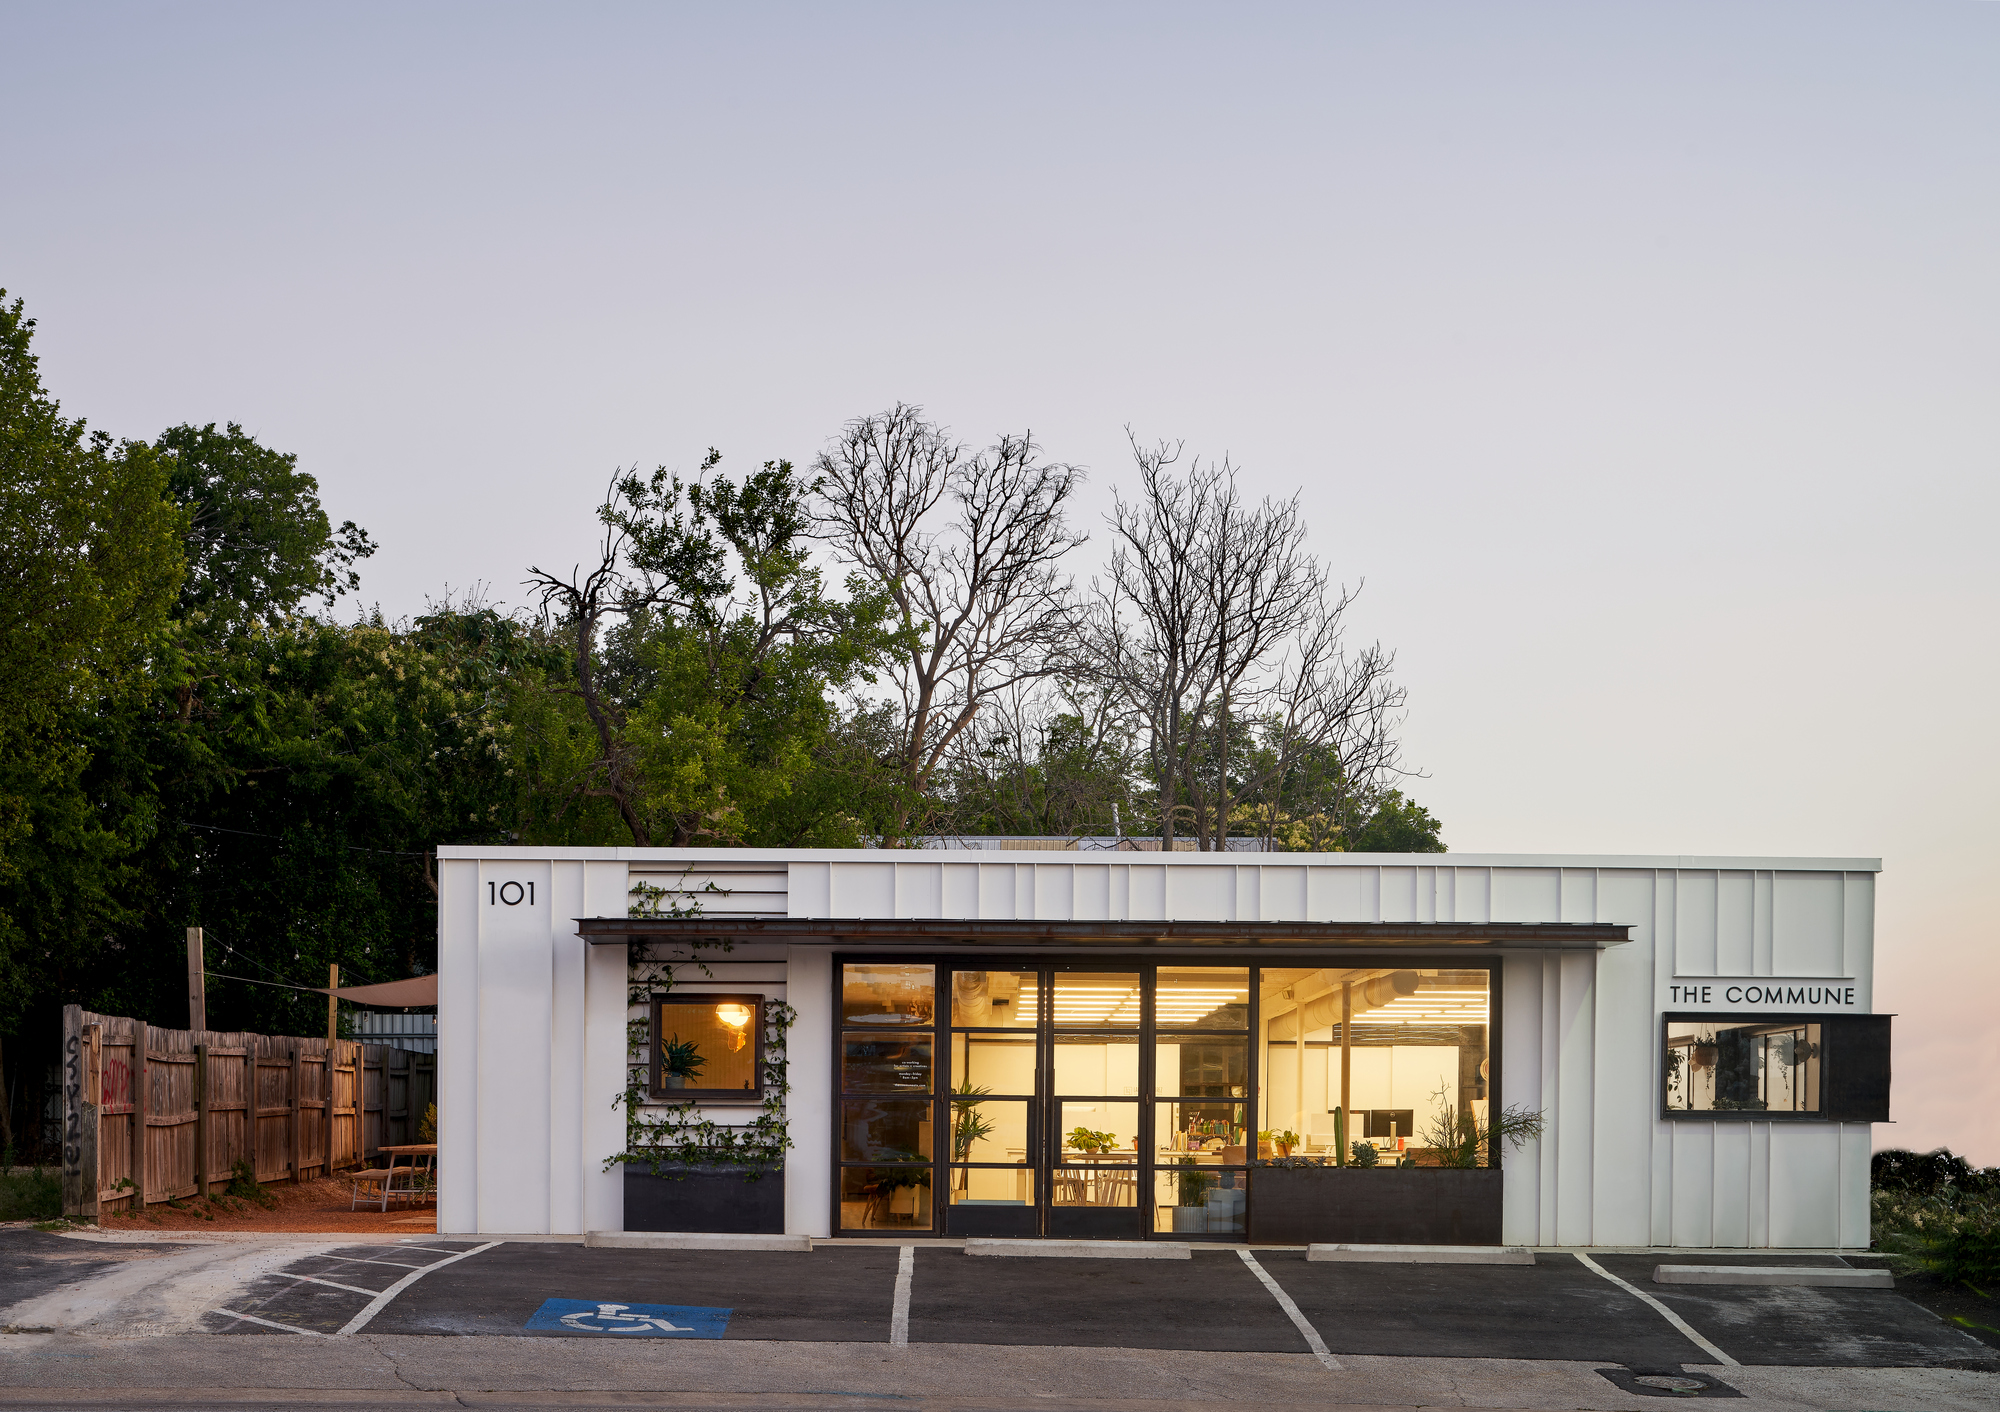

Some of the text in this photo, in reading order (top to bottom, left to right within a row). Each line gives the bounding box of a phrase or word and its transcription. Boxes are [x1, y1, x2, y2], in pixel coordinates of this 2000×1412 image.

[488, 881, 534, 906] 101
[1669, 986, 1855, 1005] THE COMMUNE
